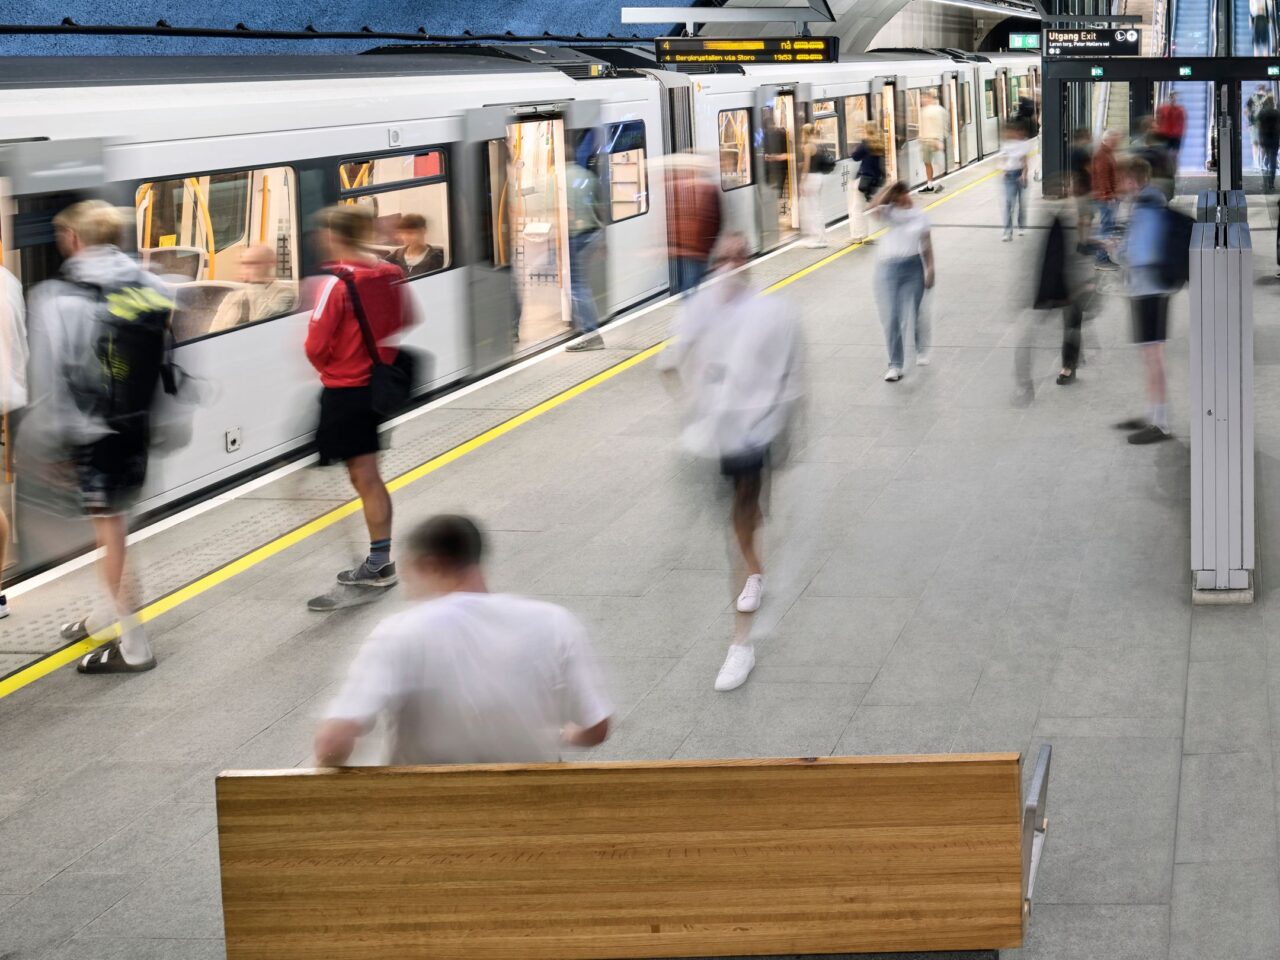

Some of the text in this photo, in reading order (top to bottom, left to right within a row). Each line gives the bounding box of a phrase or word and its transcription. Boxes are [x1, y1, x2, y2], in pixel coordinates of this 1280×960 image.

[1049, 32, 1097, 42] Utgang Exit
[663, 40, 792, 50] 4 nå
